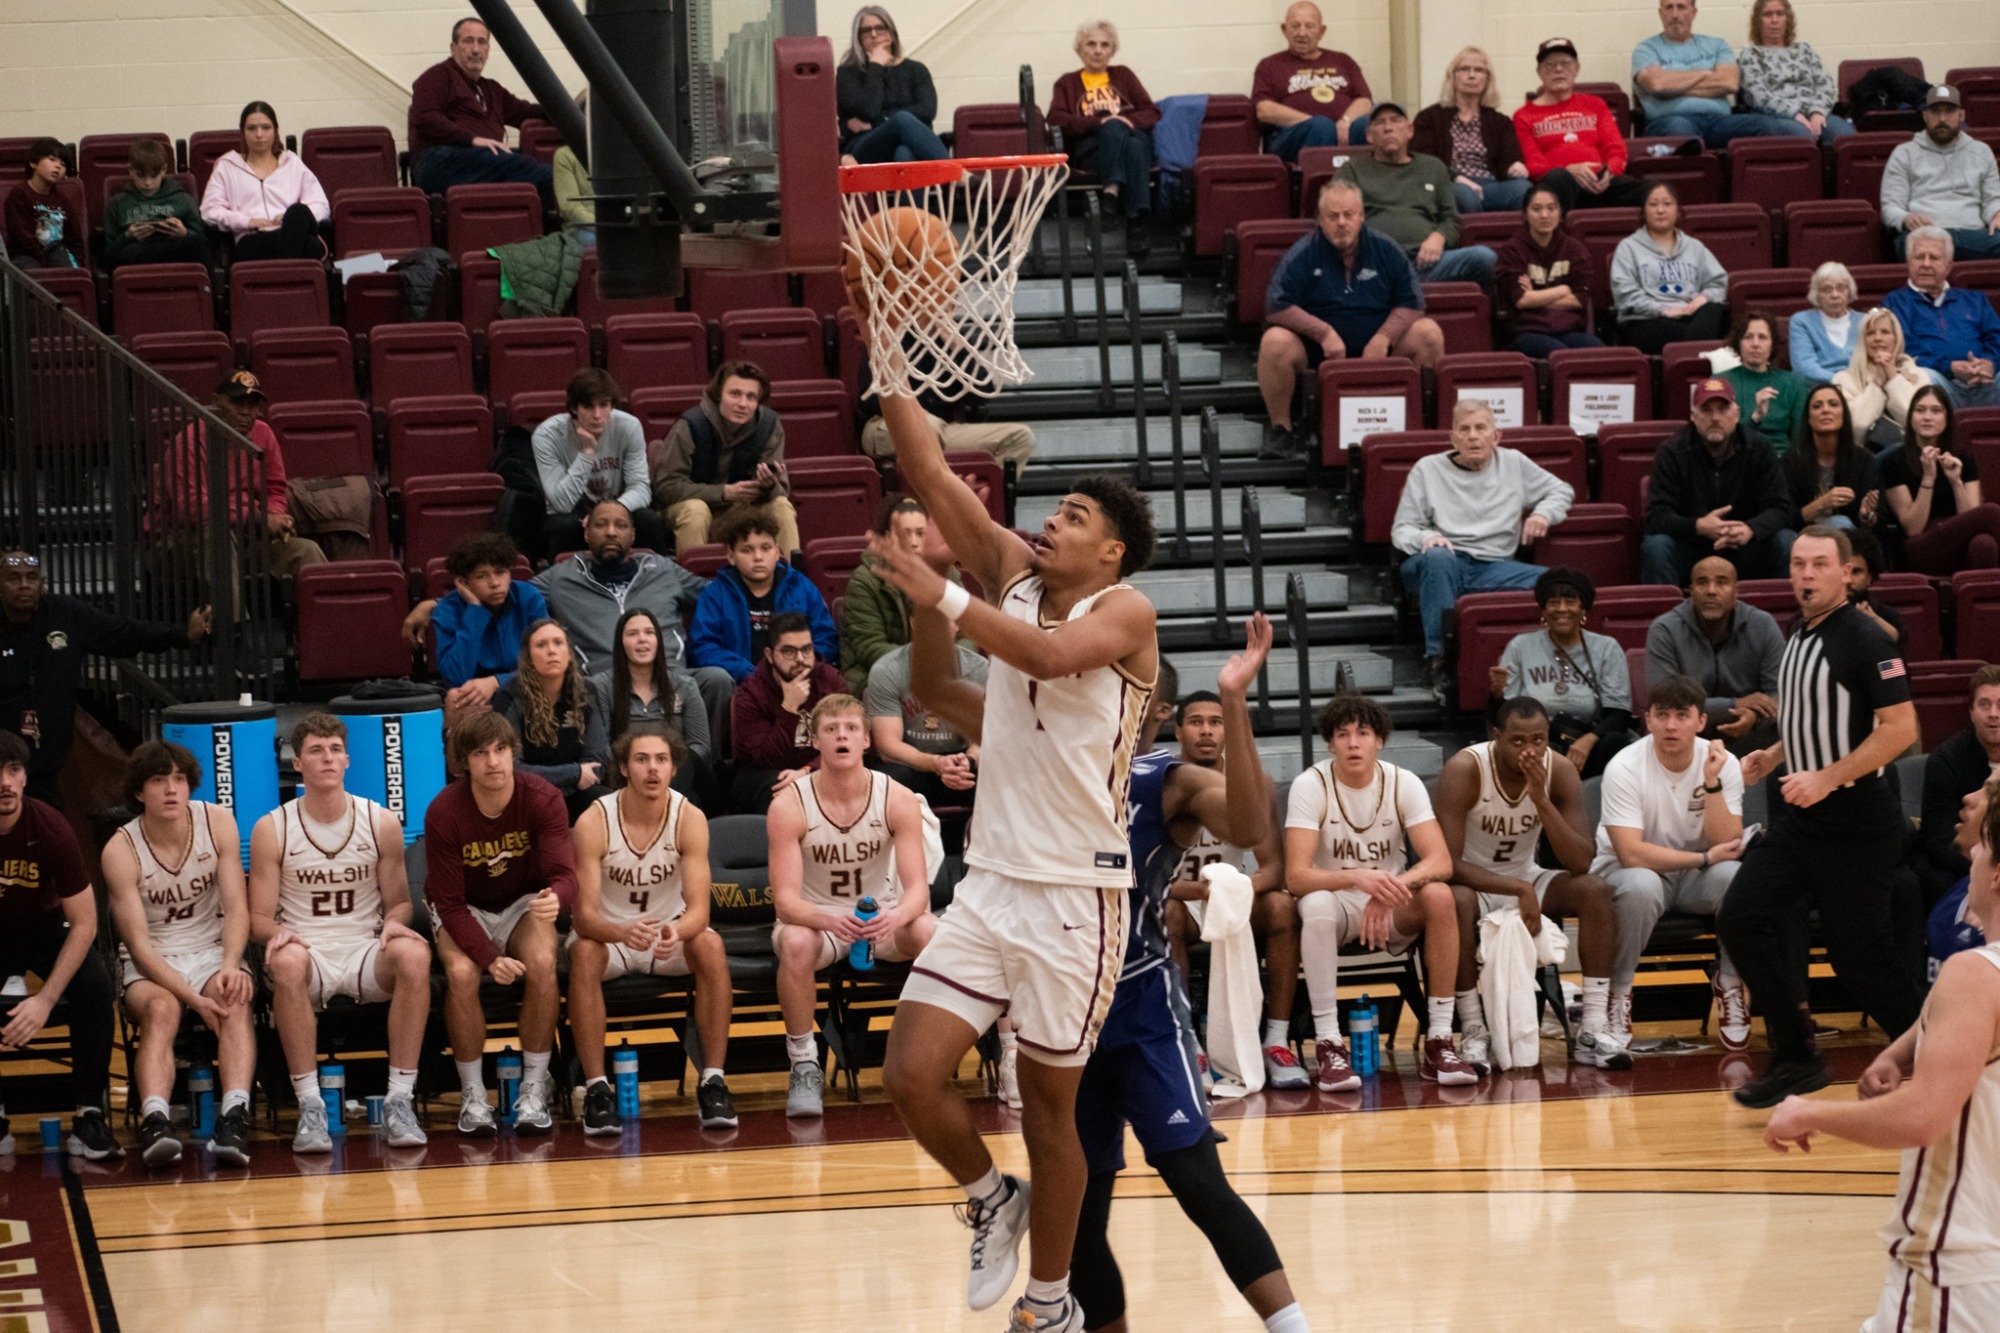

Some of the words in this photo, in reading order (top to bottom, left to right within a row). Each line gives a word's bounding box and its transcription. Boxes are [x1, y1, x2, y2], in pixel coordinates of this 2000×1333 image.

[907, 730, 953, 740] BASKETBALL
[215, 731, 233, 808] POWERA
[812, 840, 881, 864] WALSH
[1333, 838, 1391, 862] WALSH
[1493, 841, 1517, 862] 2
[0, 860, 40, 880] IERS
[296, 865, 369, 884] WALSH
[609, 864, 674, 887] WALSH
[148, 872, 213, 905] WALSH
[830, 868, 862, 897] 21
[311, 890, 354, 917] 20
[629, 891, 649, 912] 4
[711, 883, 775, 908] WALS
